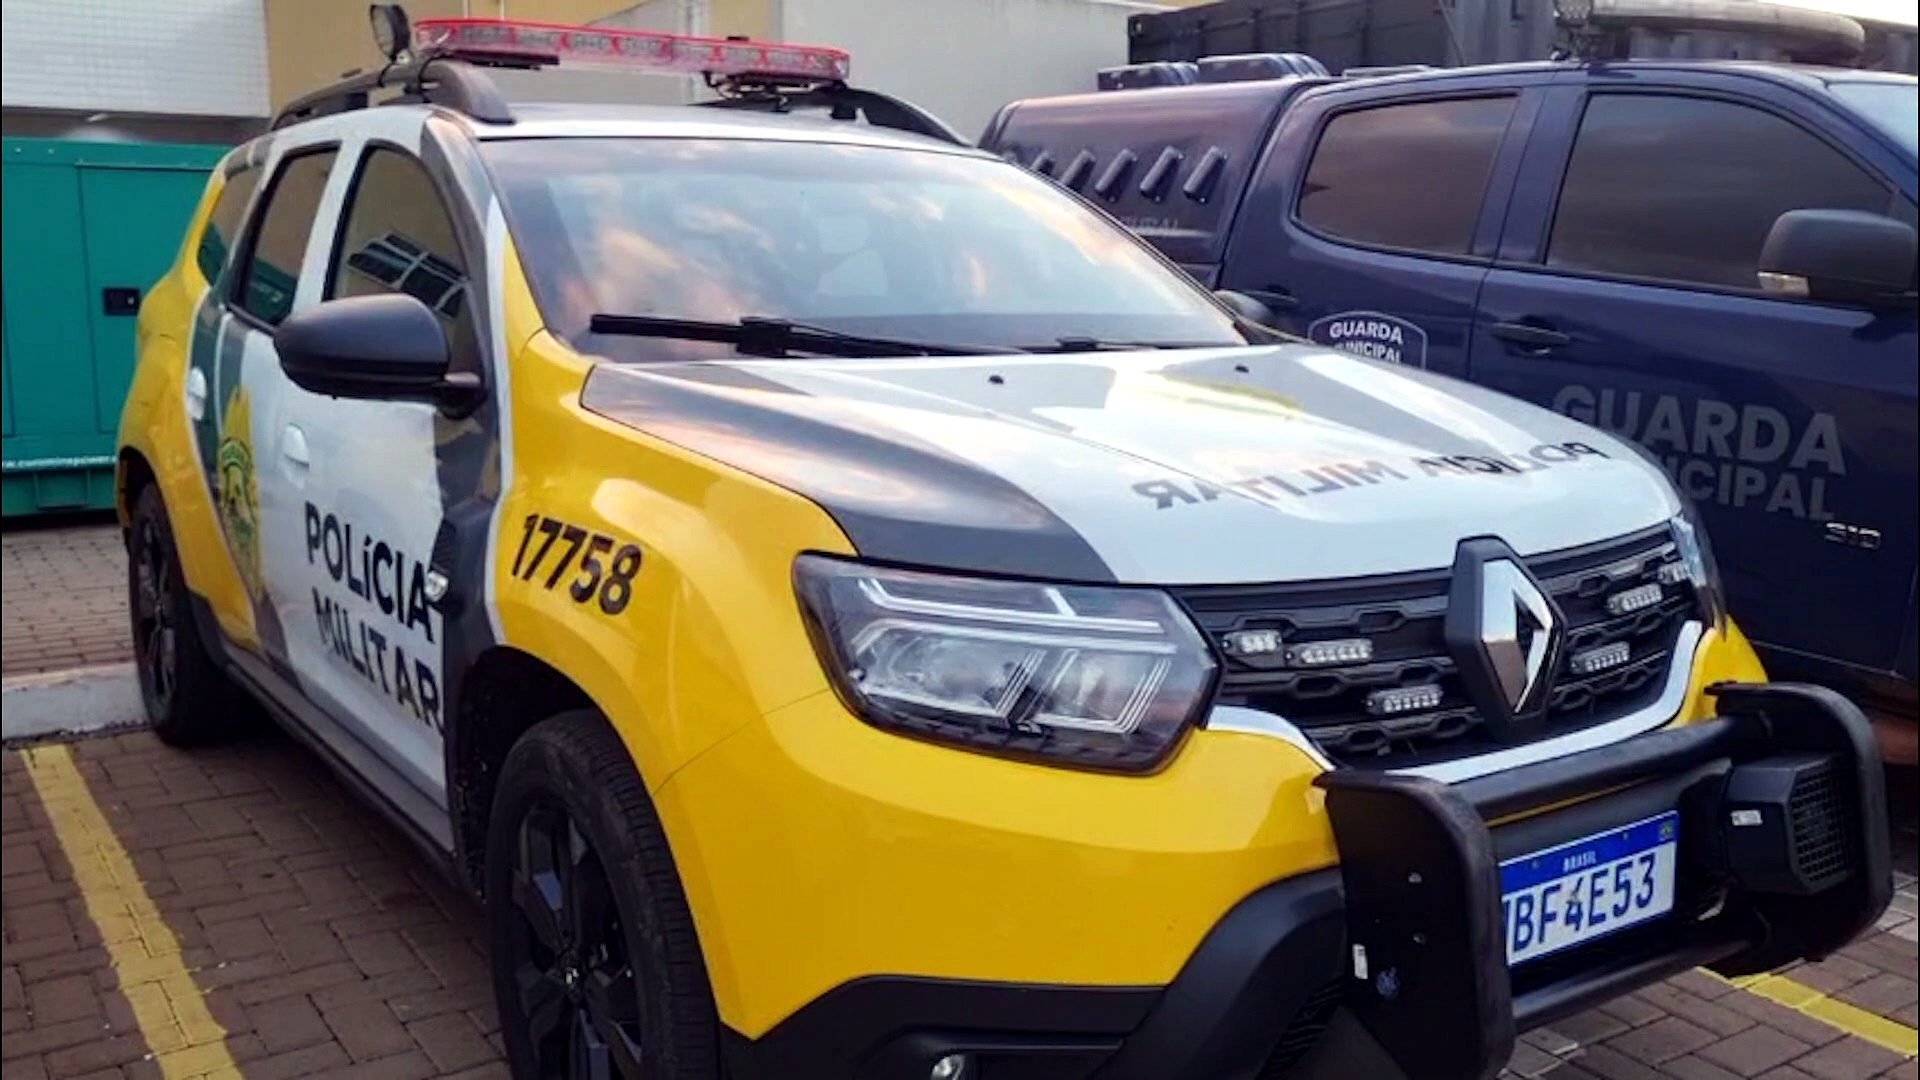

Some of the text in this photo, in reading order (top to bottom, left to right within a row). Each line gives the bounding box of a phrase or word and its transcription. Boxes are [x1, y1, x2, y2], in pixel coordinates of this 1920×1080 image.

[1329, 321, 1403, 345] GUARDA
[1553, 384, 1846, 475] GUARDA
[511, 513, 643, 616] 17758
[1824, 522, 1882, 550] S10
[312, 586, 445, 738] MILITAR
[1502, 853, 1656, 952] BF4E53
[1562, 850, 1597, 873] BRASIL
